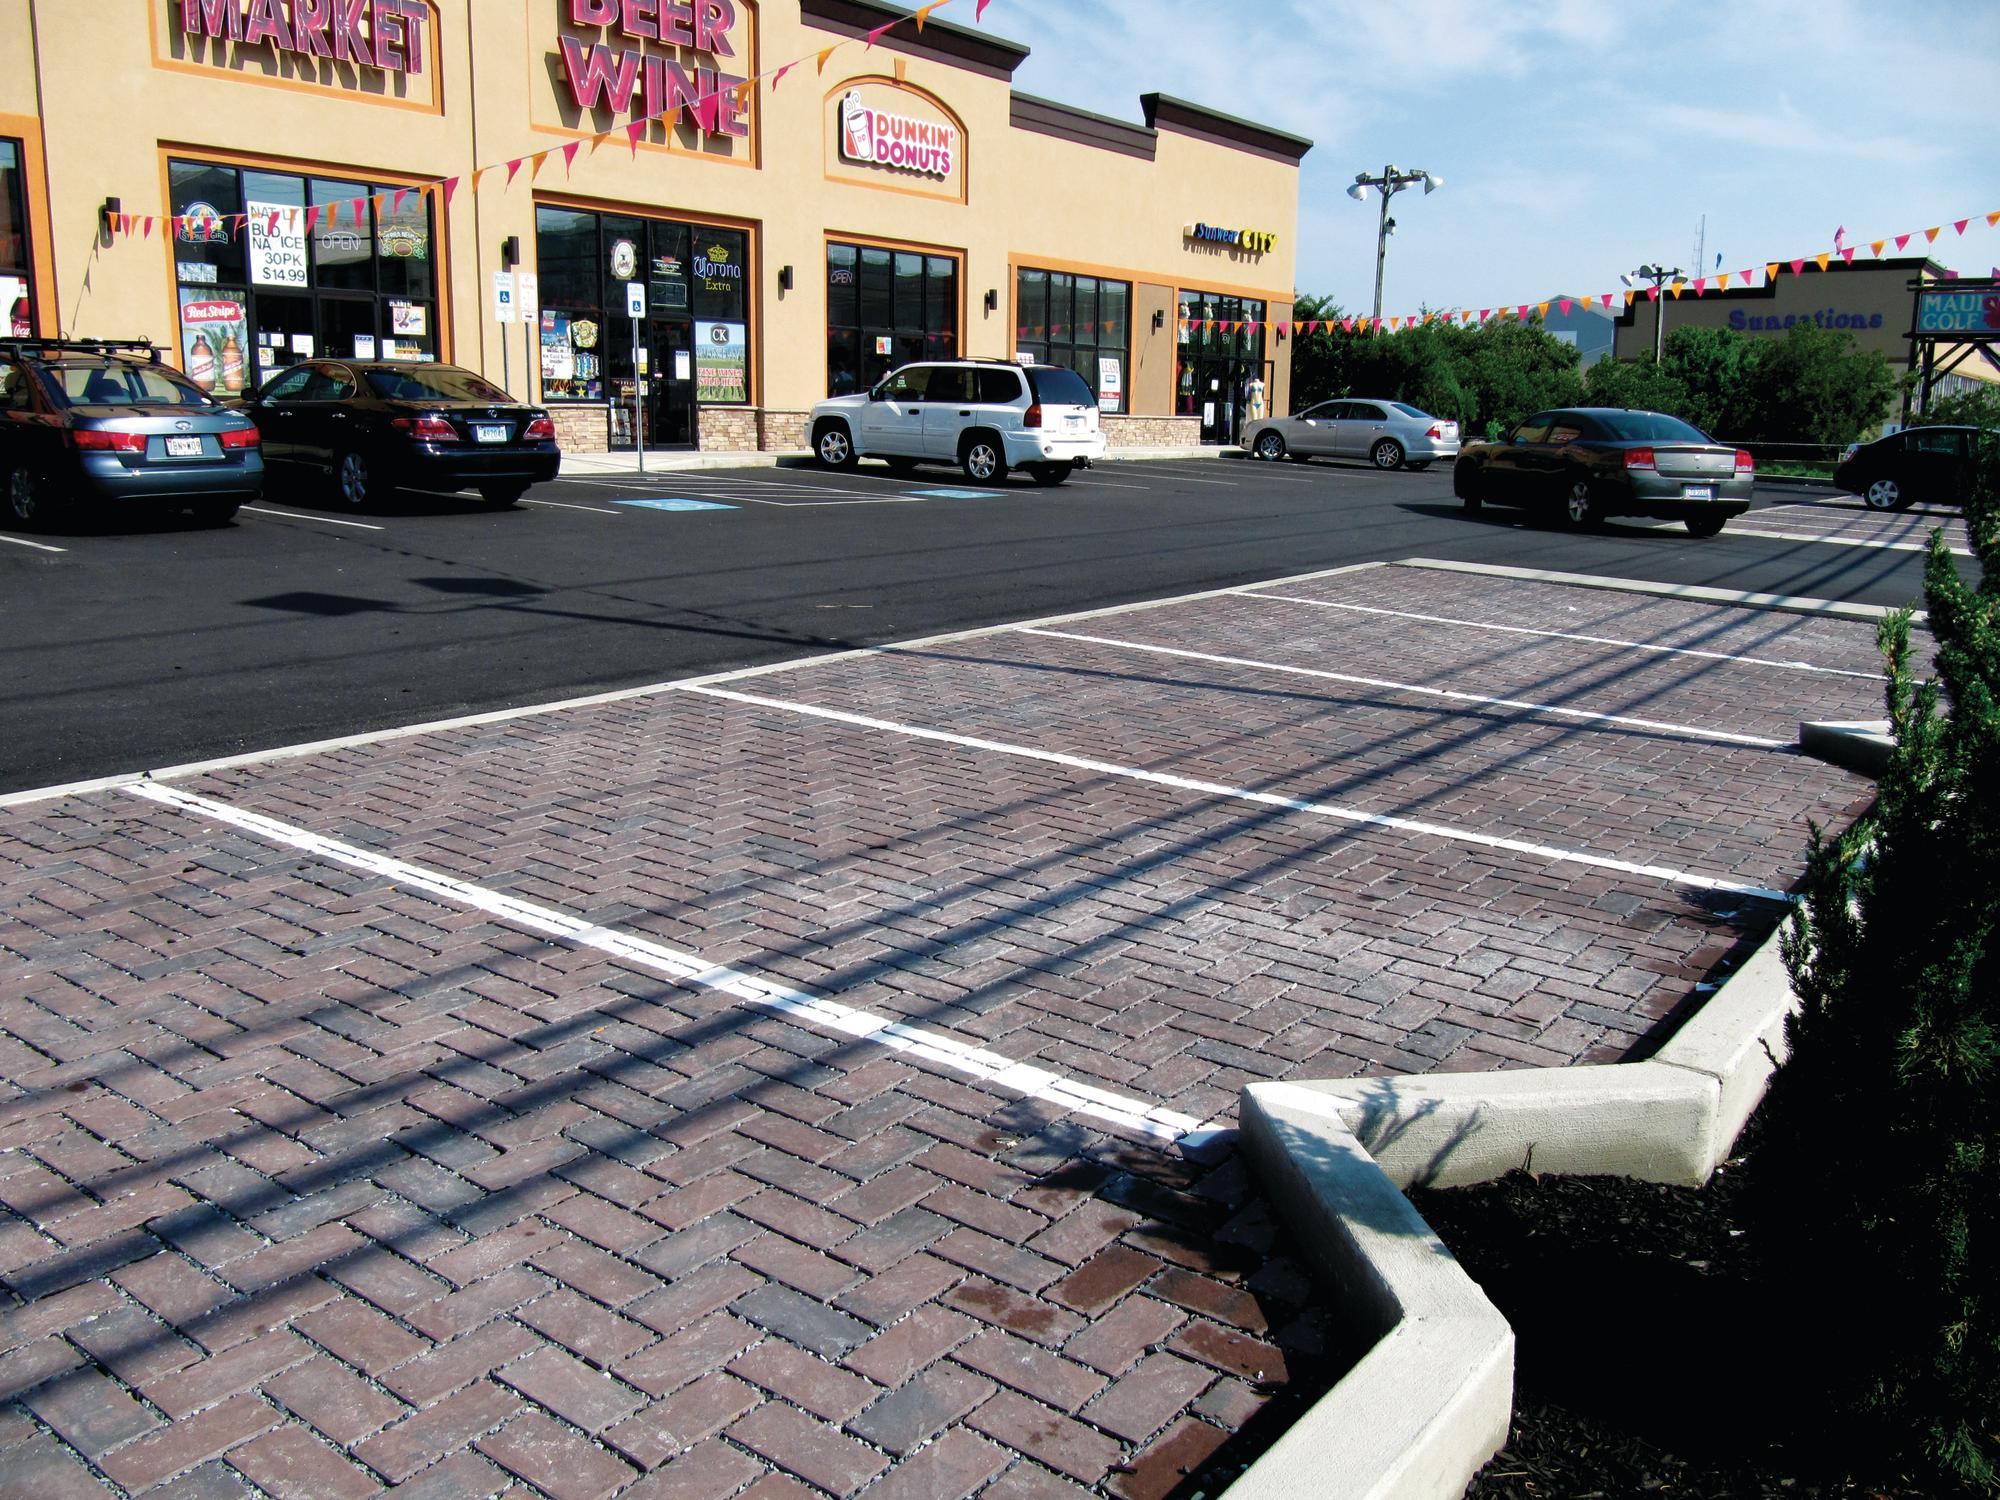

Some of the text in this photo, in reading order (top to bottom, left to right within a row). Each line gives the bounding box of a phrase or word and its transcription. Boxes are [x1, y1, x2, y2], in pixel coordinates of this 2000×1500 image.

[557, 35, 748, 137] WINE
[876, 113, 954, 149] DUNKIN'
[876, 138, 950, 174] DONUTS
[281, 236, 304, 250] ICE
[321, 234, 360, 251] OPEN
[1198, 223, 1278, 253] Sunwear CITY
[264, 252, 302, 267] 30PK
[693, 256, 741, 279] Corona
[262, 266, 306, 282] $14.99
[831, 271, 852, 284] OPEN
[705, 278, 732, 292] Extra
[1922, 294, 1985, 312] MAUI
[187, 305, 236, 319] Red Stripe
[712, 328, 727, 342] CK
